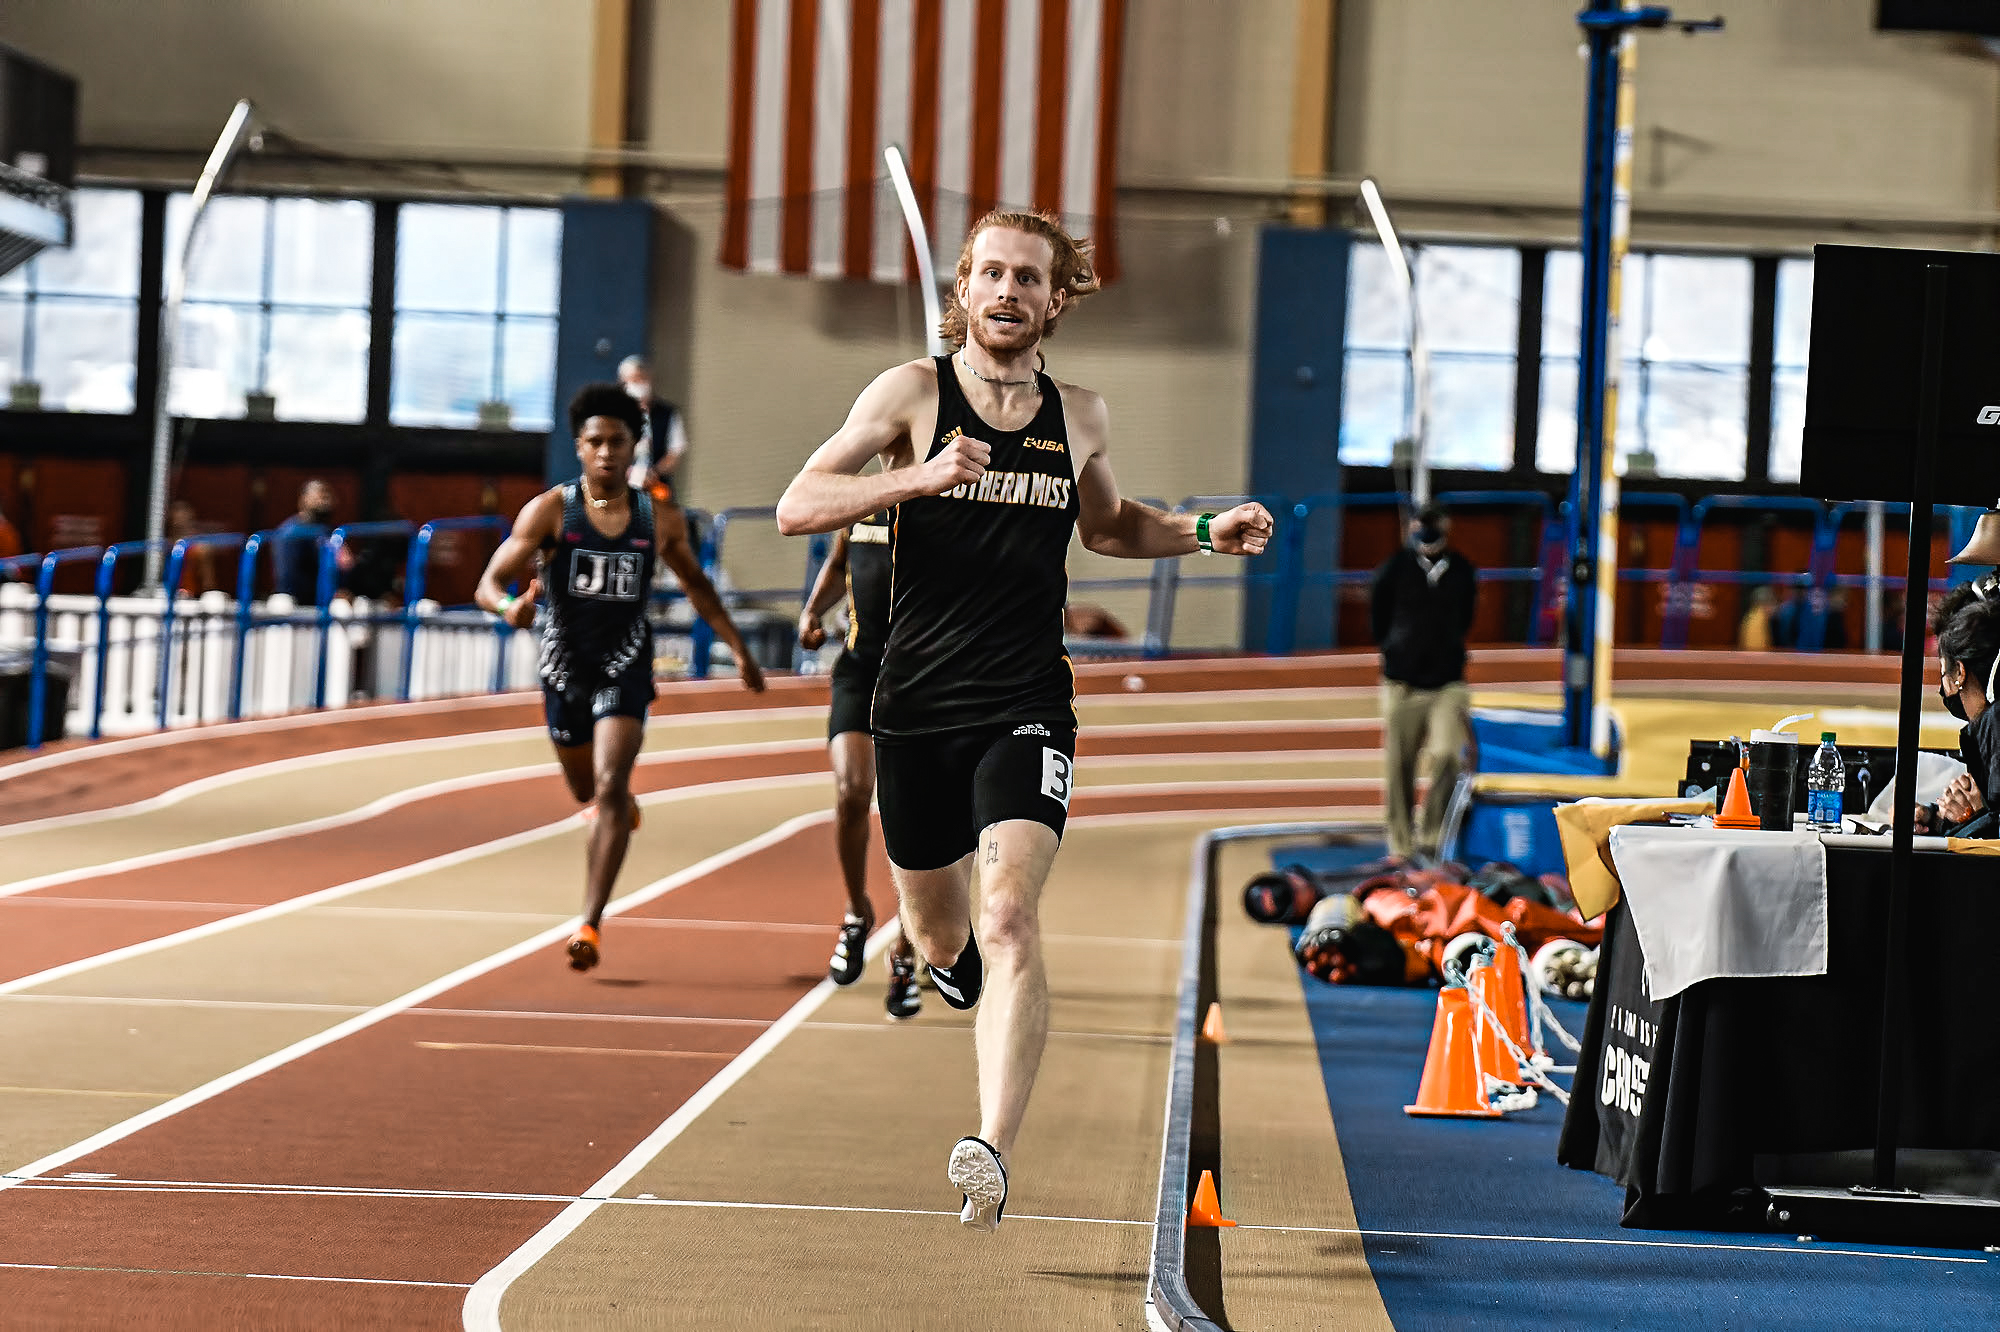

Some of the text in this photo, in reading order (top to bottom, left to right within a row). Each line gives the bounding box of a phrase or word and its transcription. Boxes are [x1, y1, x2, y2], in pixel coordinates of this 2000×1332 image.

[1977, 405, 2000, 425] G
[1029, 472, 1070, 510] MISS
[1013, 726, 1051, 737] adidas
[1050, 753, 1069, 801] 3
